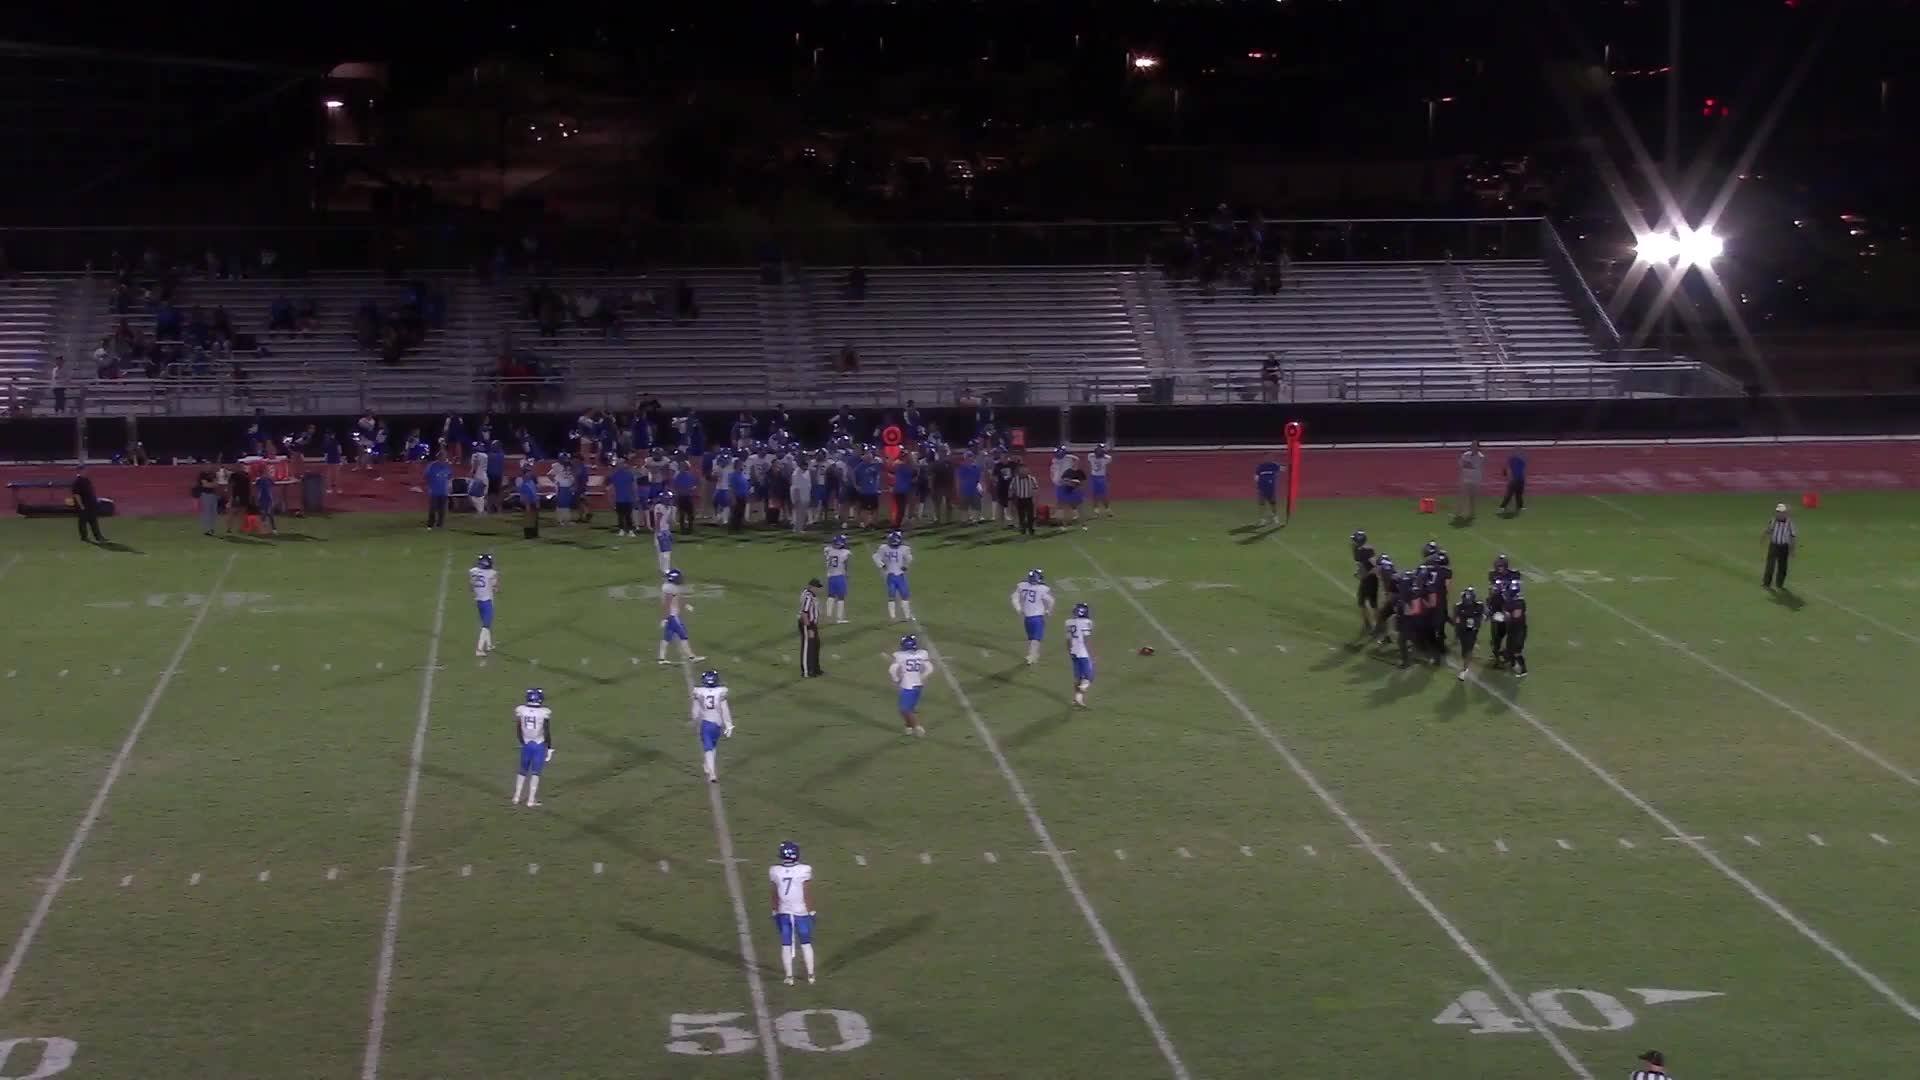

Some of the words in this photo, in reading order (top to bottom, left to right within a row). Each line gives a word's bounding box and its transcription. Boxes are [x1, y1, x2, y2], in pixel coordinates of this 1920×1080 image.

[1022, 588, 1036, 604] 79
[905, 658, 921, 672] 56
[706, 695, 715, 710] 3
[524, 716, 537, 729] 14
[782, 877, 793, 896] 7
[1432, 988, 1636, 1034] 40
[664, 1008, 873, 1055] 50
